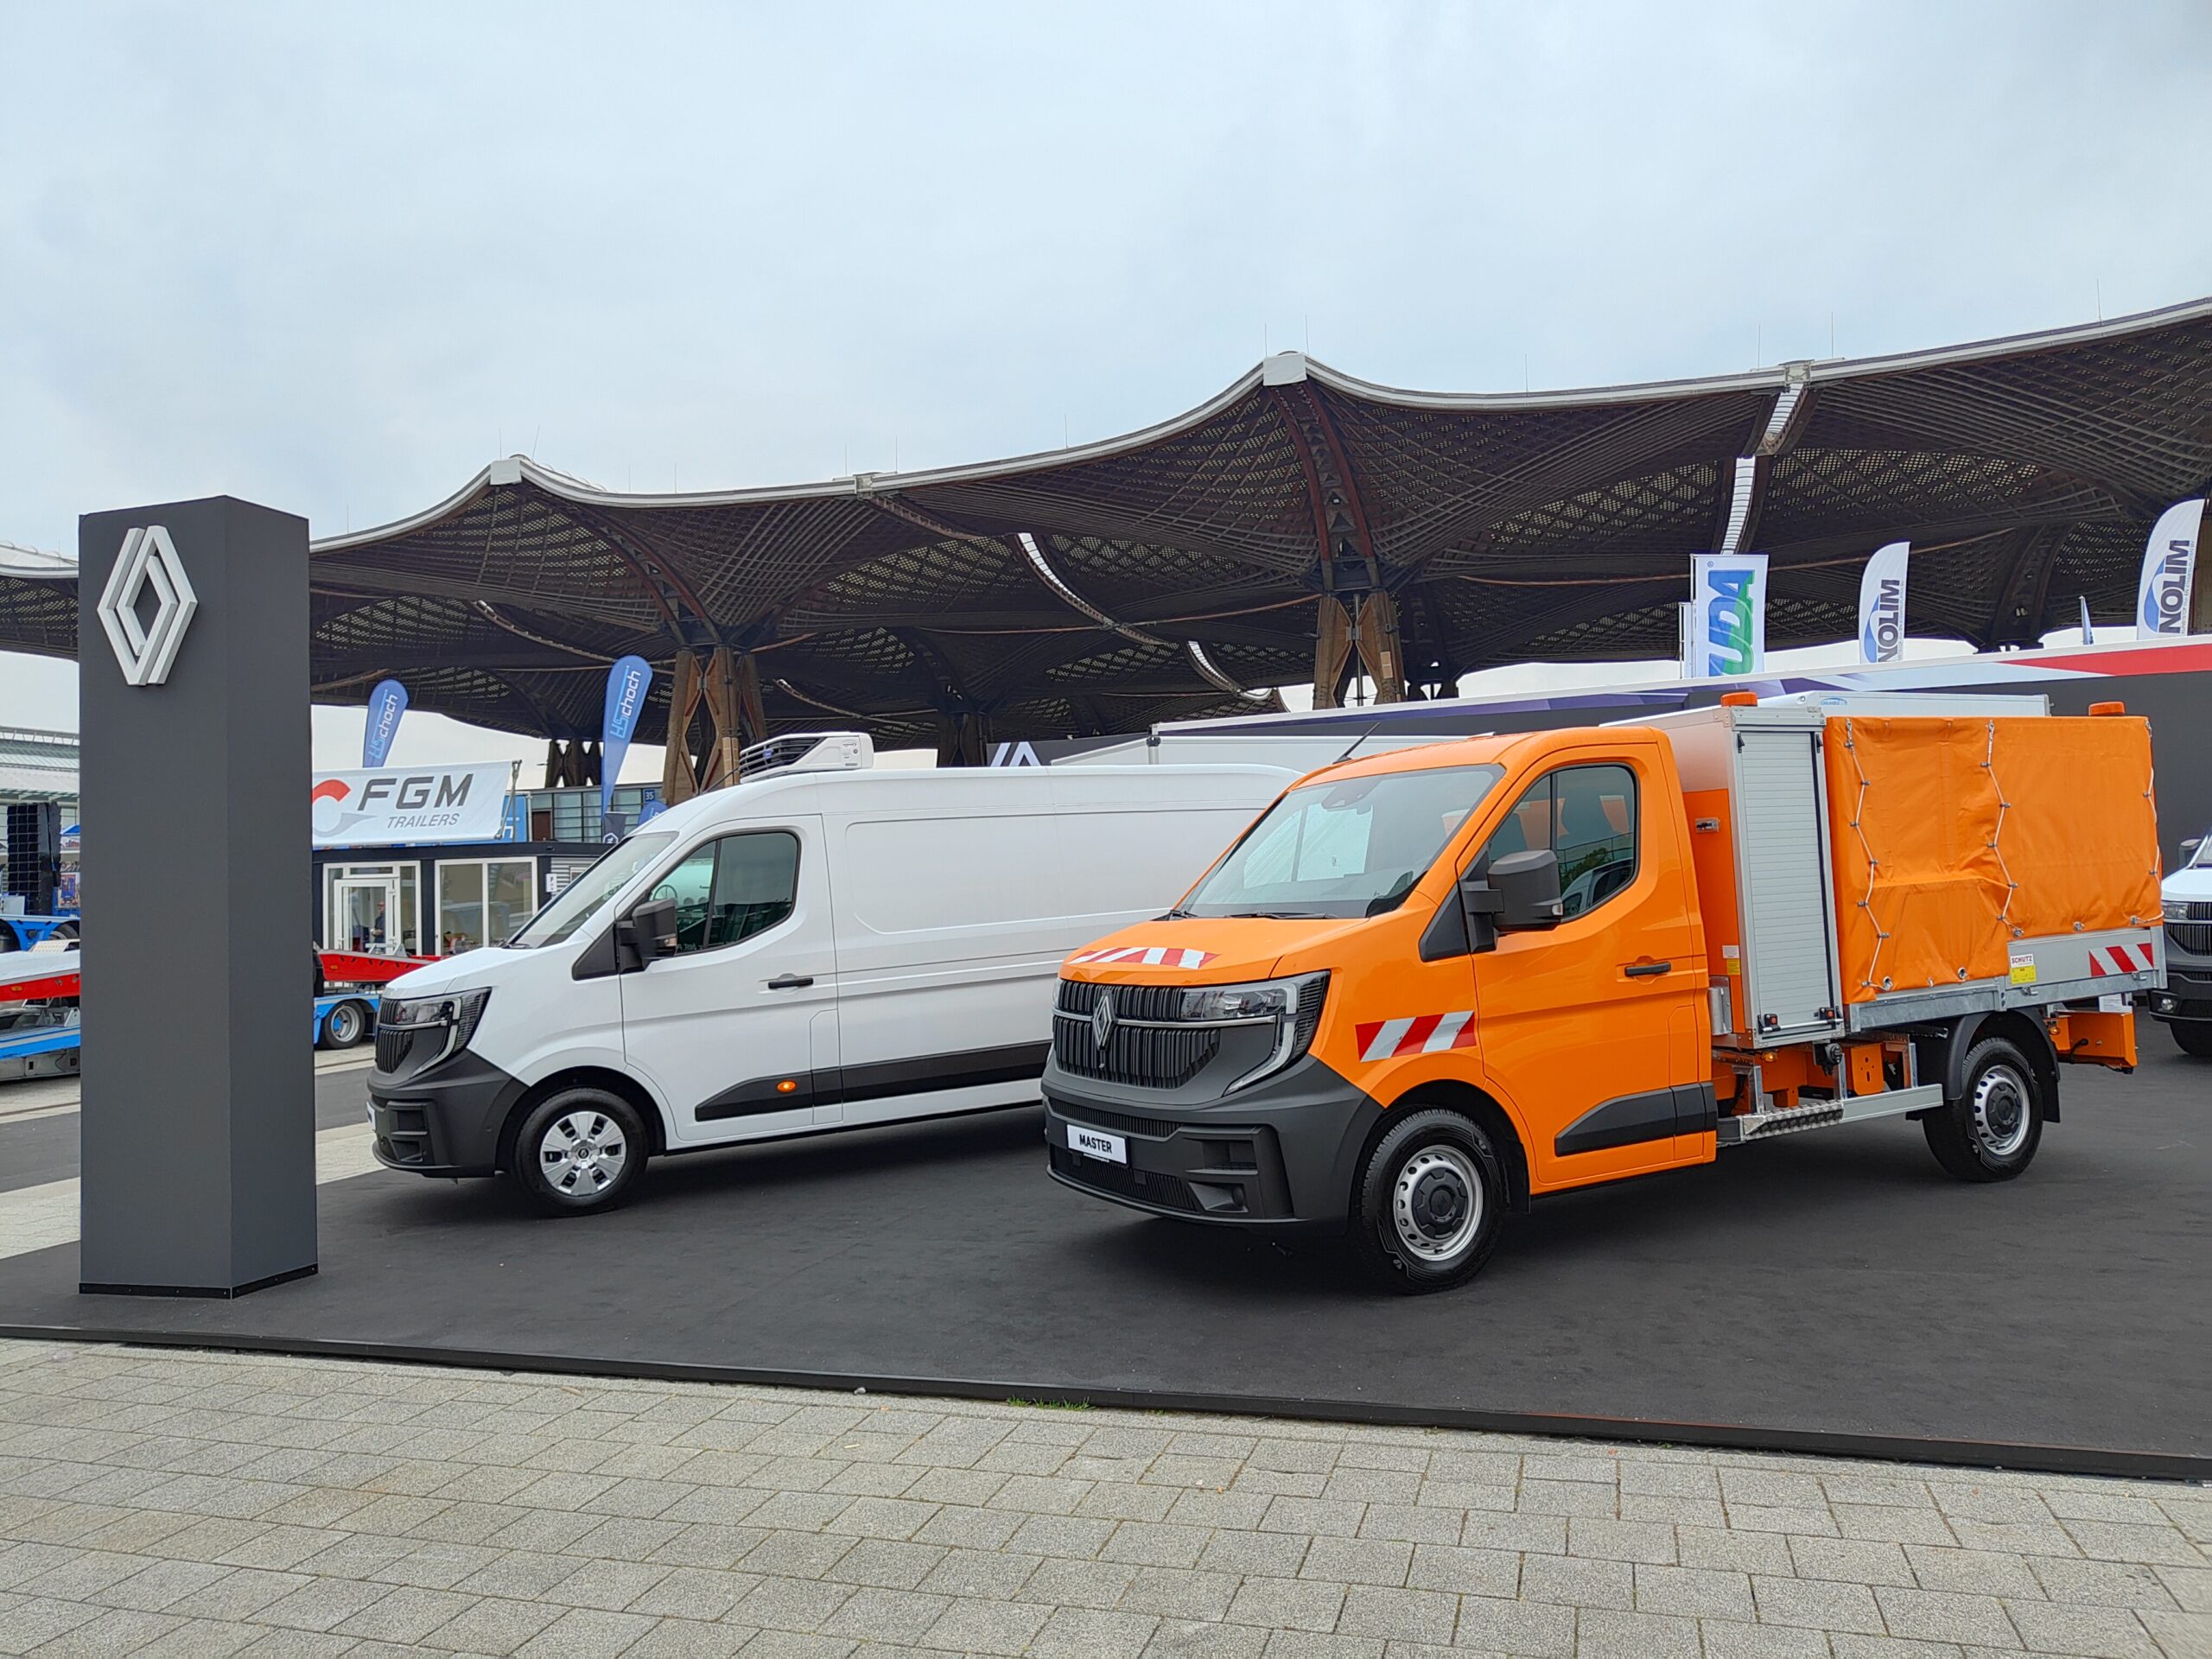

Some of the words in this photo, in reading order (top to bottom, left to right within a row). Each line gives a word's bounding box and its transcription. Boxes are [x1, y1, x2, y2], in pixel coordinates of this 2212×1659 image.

[2159, 540, 2190, 633] NOLIM
[1878, 579, 1900, 662] NOLIM
[357, 773, 474, 811] FGM
[387, 813, 460, 829] TRAILERS
[1079, 1134, 1112, 1154] MASTER
